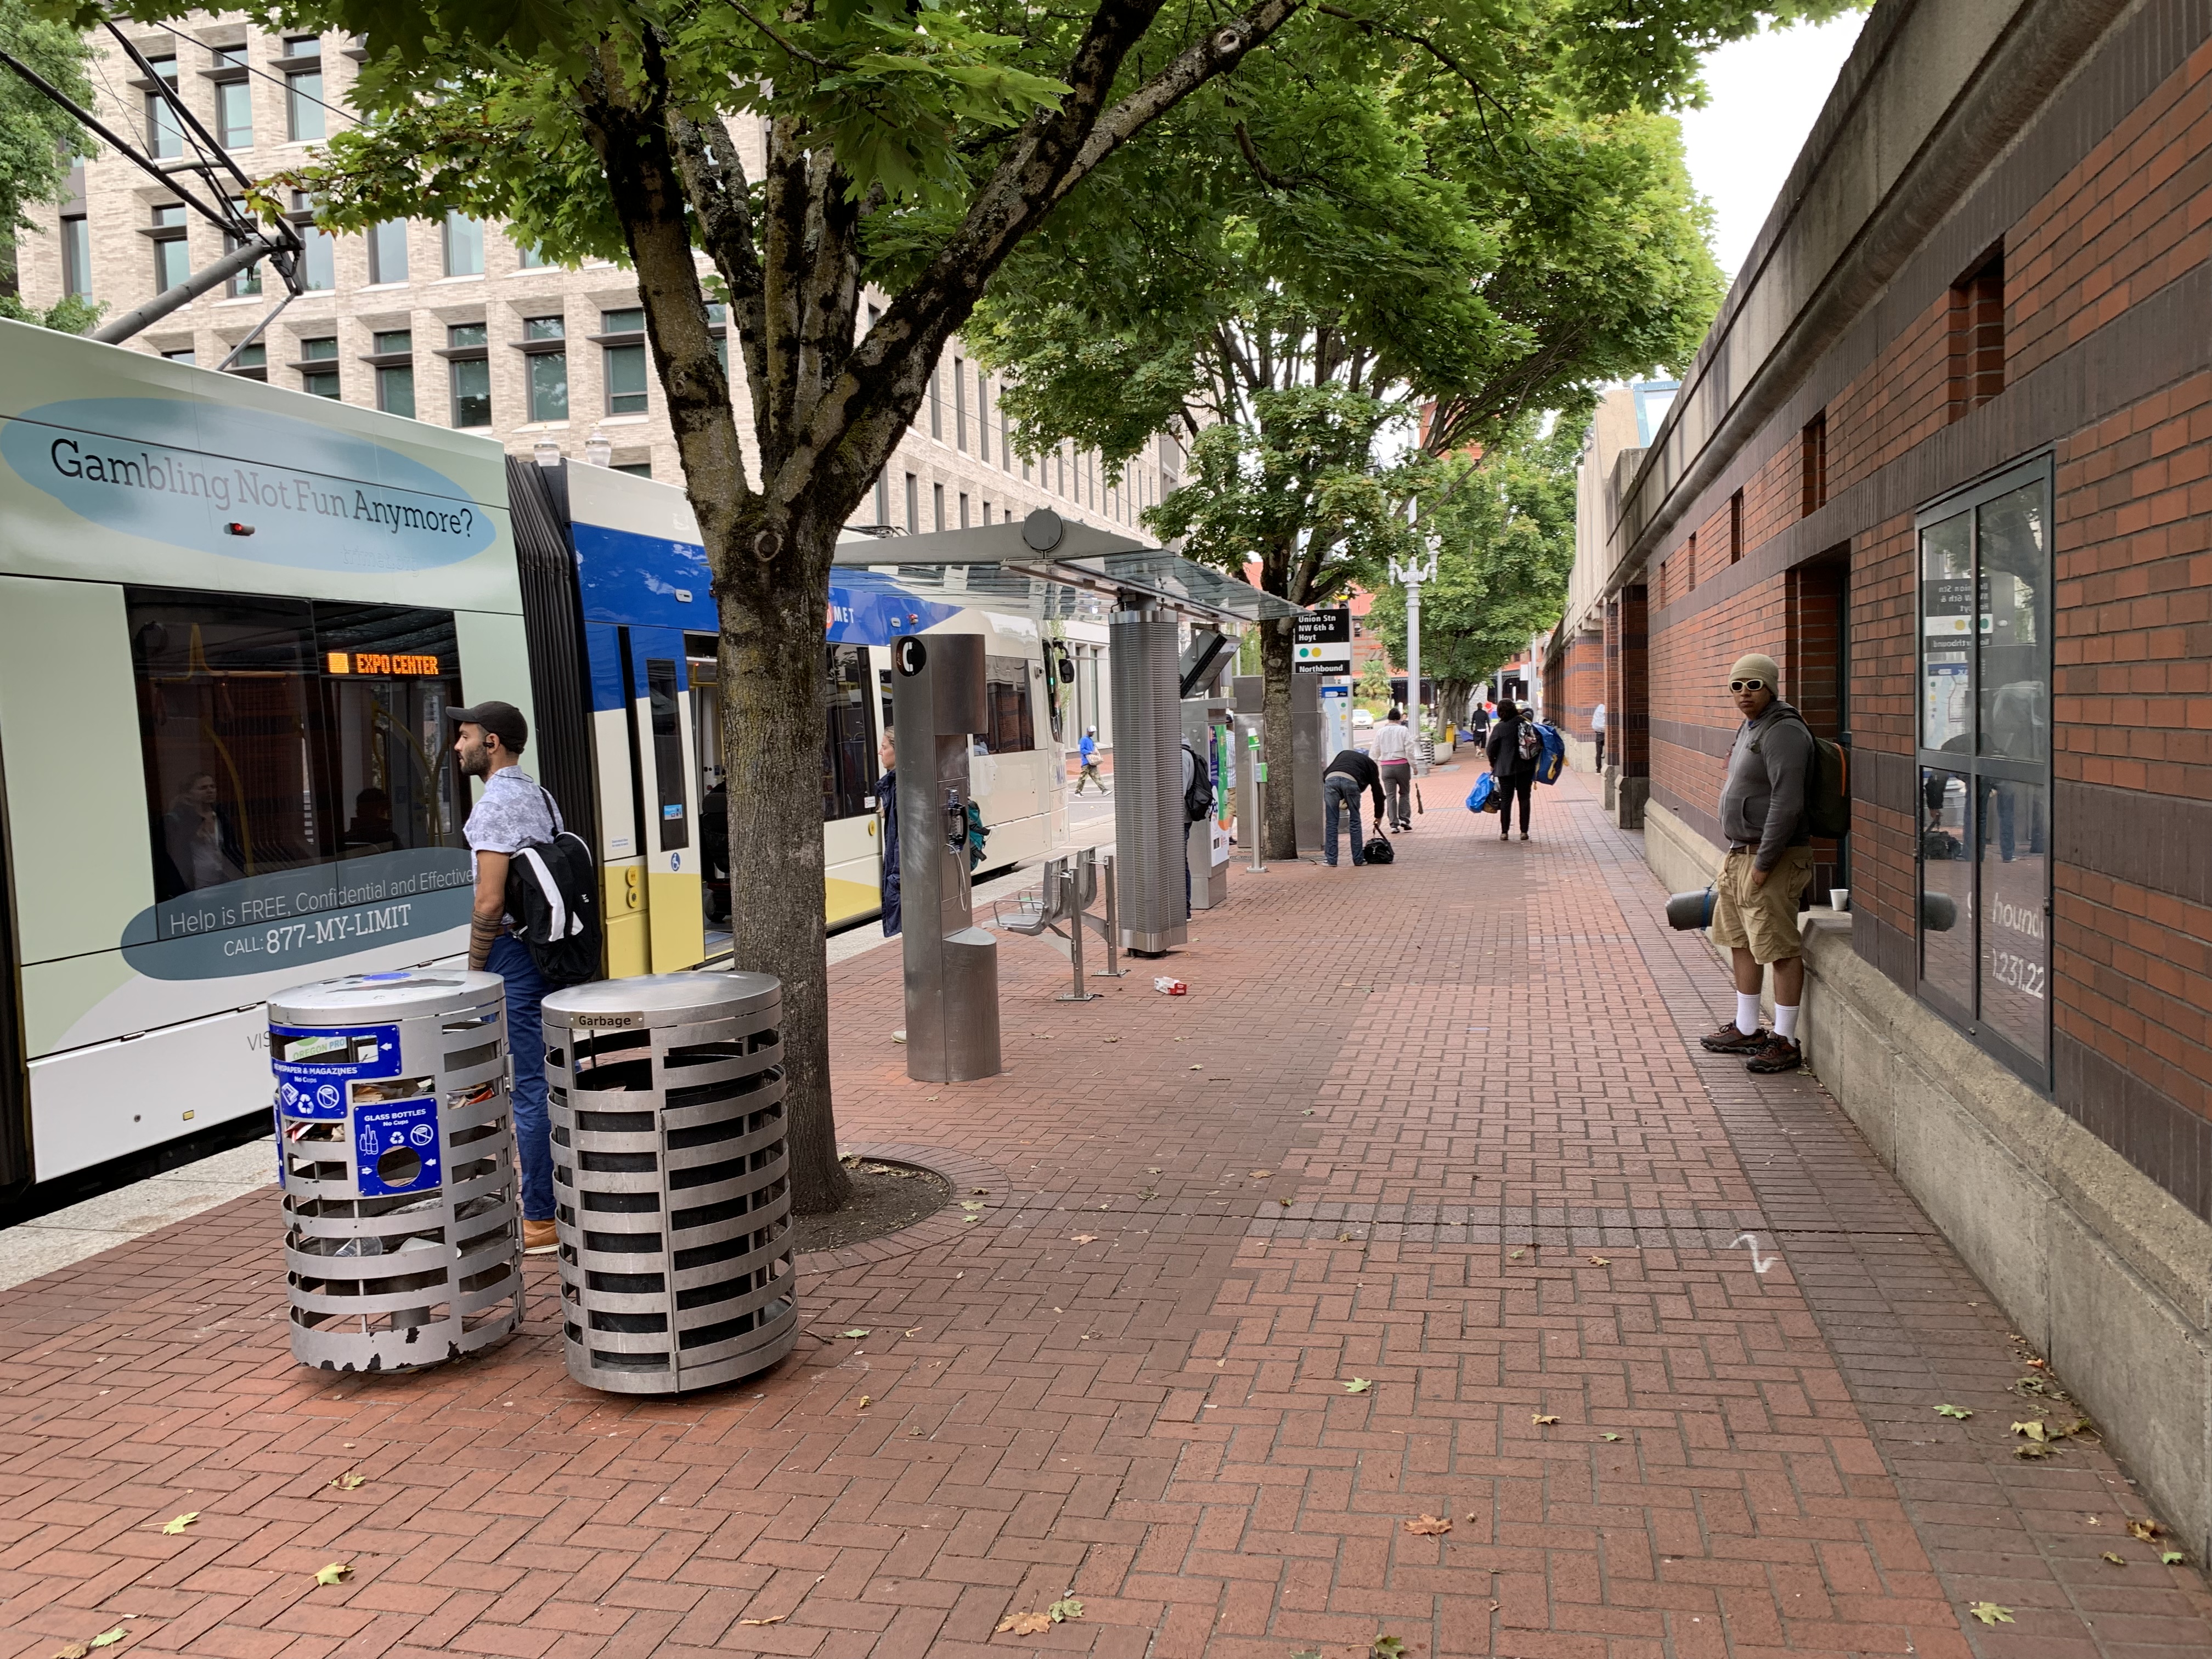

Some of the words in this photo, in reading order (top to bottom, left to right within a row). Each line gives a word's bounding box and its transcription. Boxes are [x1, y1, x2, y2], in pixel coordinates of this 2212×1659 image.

[51, 438, 230, 511] Gambling
[234, 469, 291, 509] Not
[293, 478, 348, 518] Fun
[353, 489, 473, 538] Anymore?
[1298, 614, 1321, 623] Union
[1299, 634, 1317, 642] Hoyt
[357, 653, 391, 674] EXPO
[392, 655, 439, 675] CENTER
[1299, 664, 1344, 673] Northbound
[171, 909, 216, 934] Help
[222, 906, 236, 926] is
[241, 895, 291, 922] FREE,
[296, 879, 386, 912] Confidential
[391, 874, 416, 896] and
[420, 868, 475, 890] Effective
[224, 936, 264, 956] CALL:
[267, 904, 411, 953] 877-MY-LIMIT
[579, 1015, 631, 1028] Garbage
[293, 1043, 328, 1060] OREGON
[274, 1062, 302, 1074] NEWSPAPER
[309, 1066, 358, 1075] MAGAZINES
[364, 1113, 390, 1122] GLASS
[391, 1109, 426, 1119] BOTTLES
